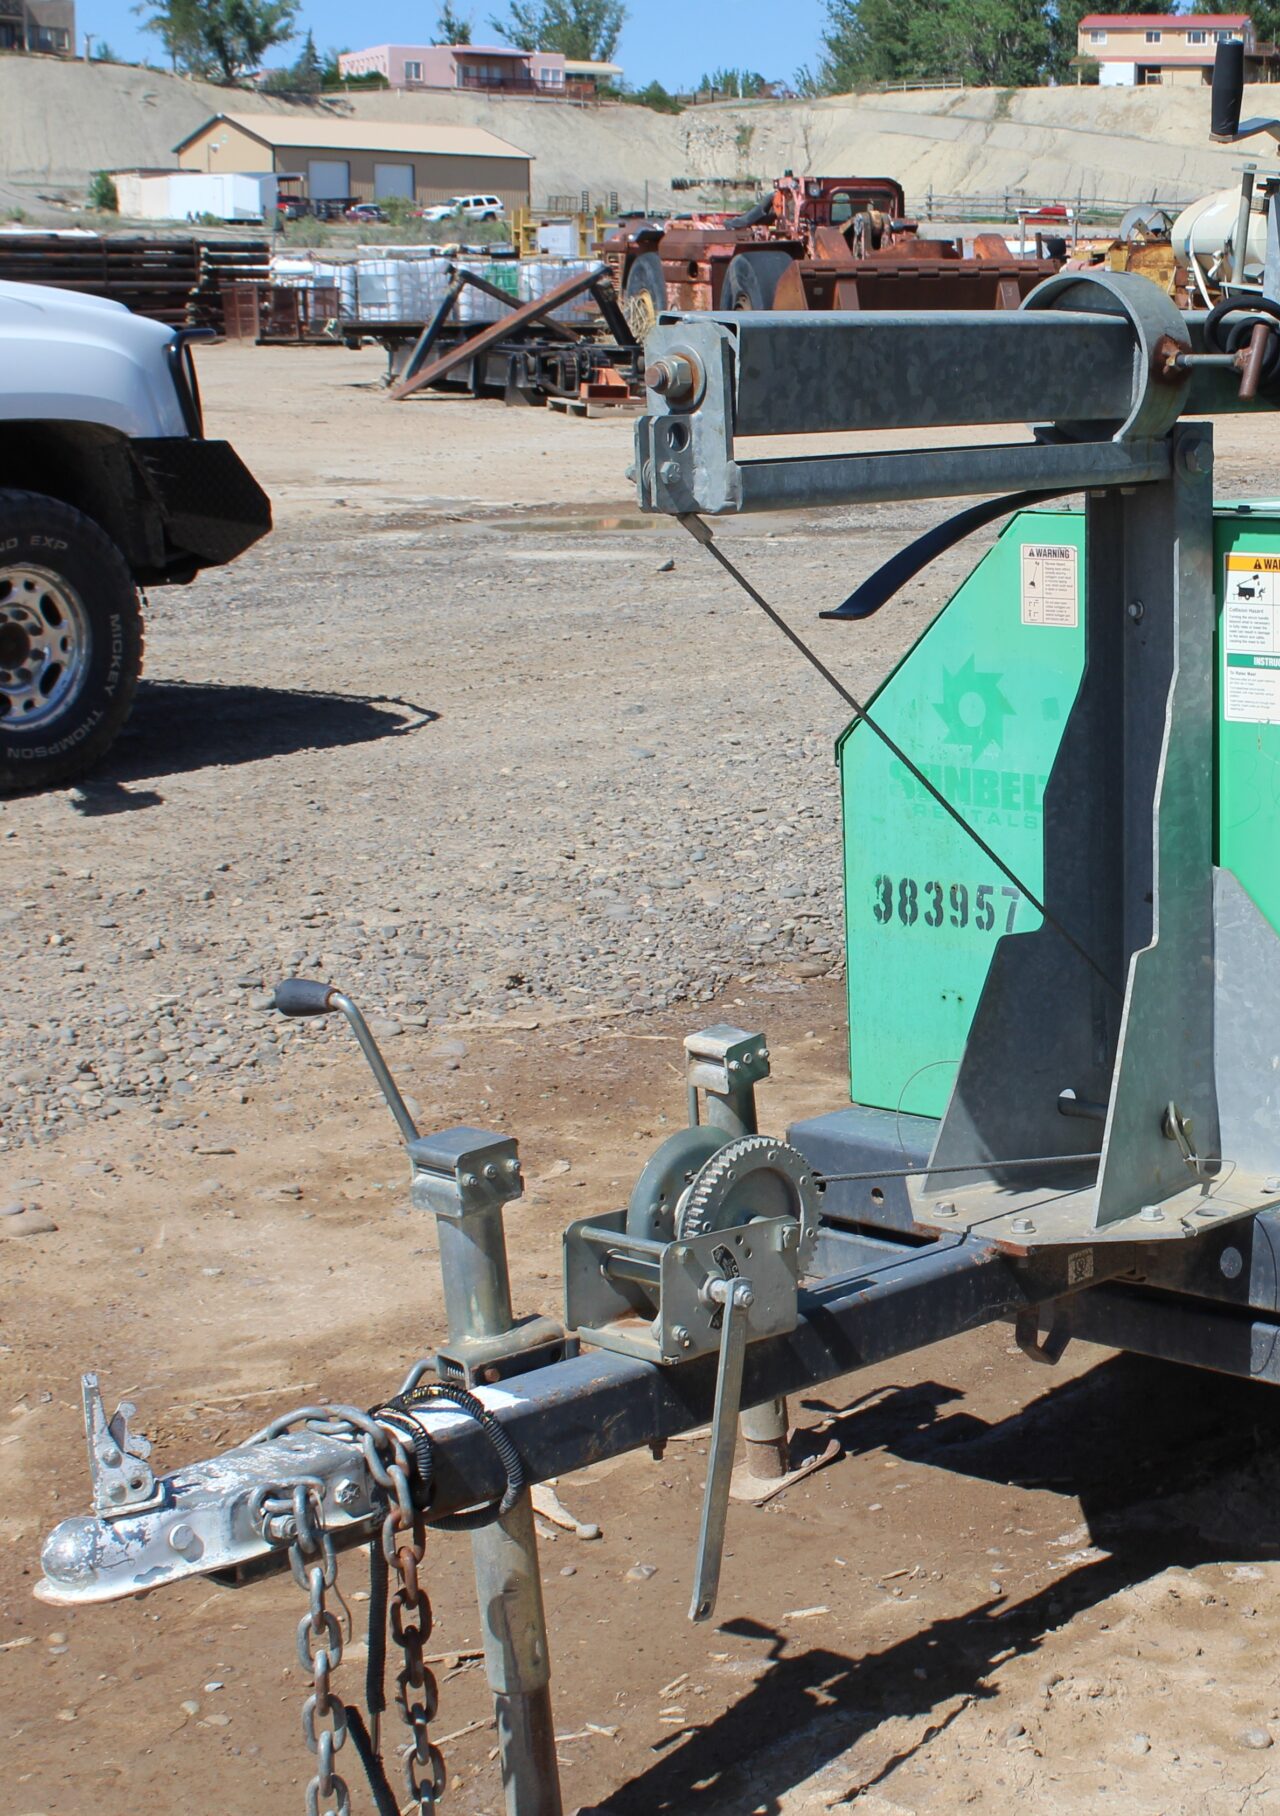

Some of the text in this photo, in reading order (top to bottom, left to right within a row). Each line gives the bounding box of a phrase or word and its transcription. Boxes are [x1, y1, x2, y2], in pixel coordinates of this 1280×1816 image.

[30, 535, 69, 551] EXP
[1036, 548, 1070, 559] WARNING
[6, 613, 124, 760] MICKEY THOMPSON
[911, 803, 1039, 830] RETALS
[873, 873, 1021, 934] 383957
